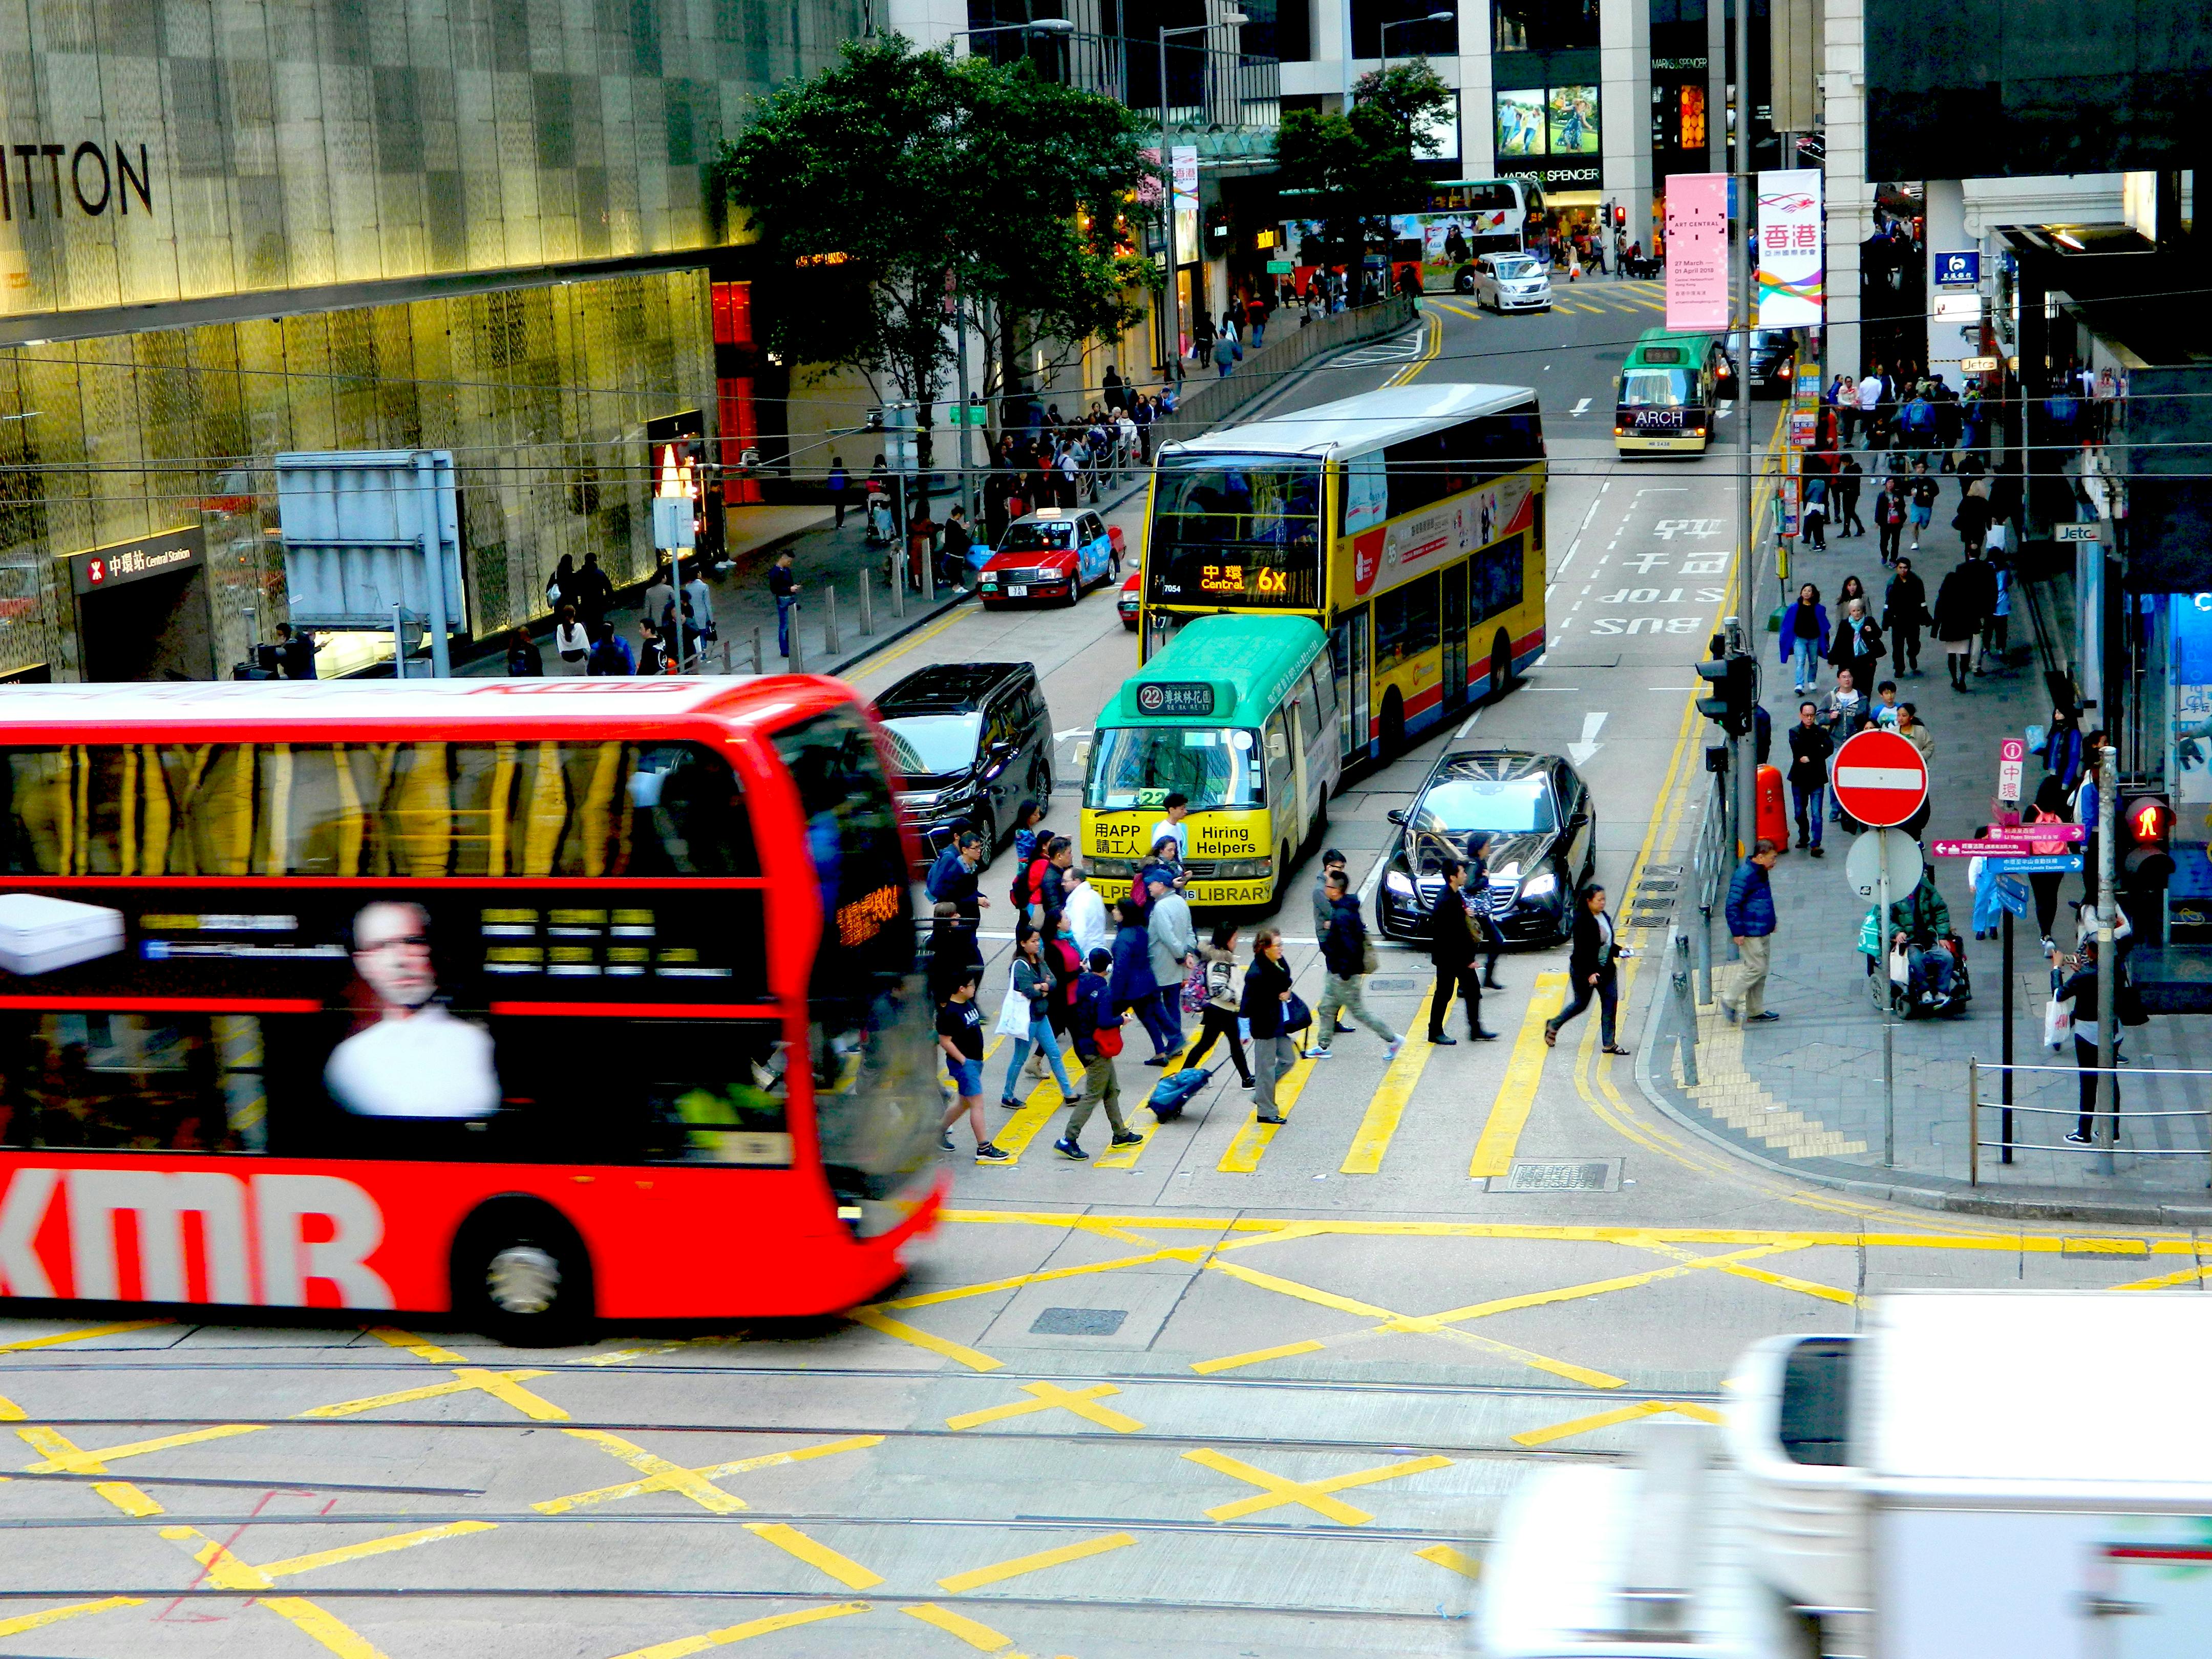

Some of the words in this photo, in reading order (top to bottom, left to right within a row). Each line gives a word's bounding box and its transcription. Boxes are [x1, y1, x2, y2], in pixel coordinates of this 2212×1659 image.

[1652, 58, 1674, 69] MARKS
[1679, 58, 1707, 69] SPENCER
[1539, 171, 1546, 181] &
[1547, 168, 1599, 181] SPENCER
[1764, 224, 1816, 248] 香港
[1635, 411, 1683, 424] ARCH
[109, 549, 144, 577] 中環站
[146, 551, 168, 567] Central
[168, 548, 190, 562] Station
[1203, 565, 1243, 580] 中環
[1201, 578, 1245, 589] Central
[1595, 587, 1726, 603] STOP
[1590, 618, 1703, 635] BUS
[1144, 689, 1160, 704] 22
[2003, 765, 2018, 798] 中環
[1142, 792, 1165, 805] 22
[1095, 823, 1141, 837] 用APP
[1202, 826, 1248, 840] Hiring
[1096, 839, 1140, 855] 請工人
[1197, 841, 1256, 856] Helpers
[1091, 884, 1131, 898] LPE
[1198, 884, 1270, 901] LIBRARY
